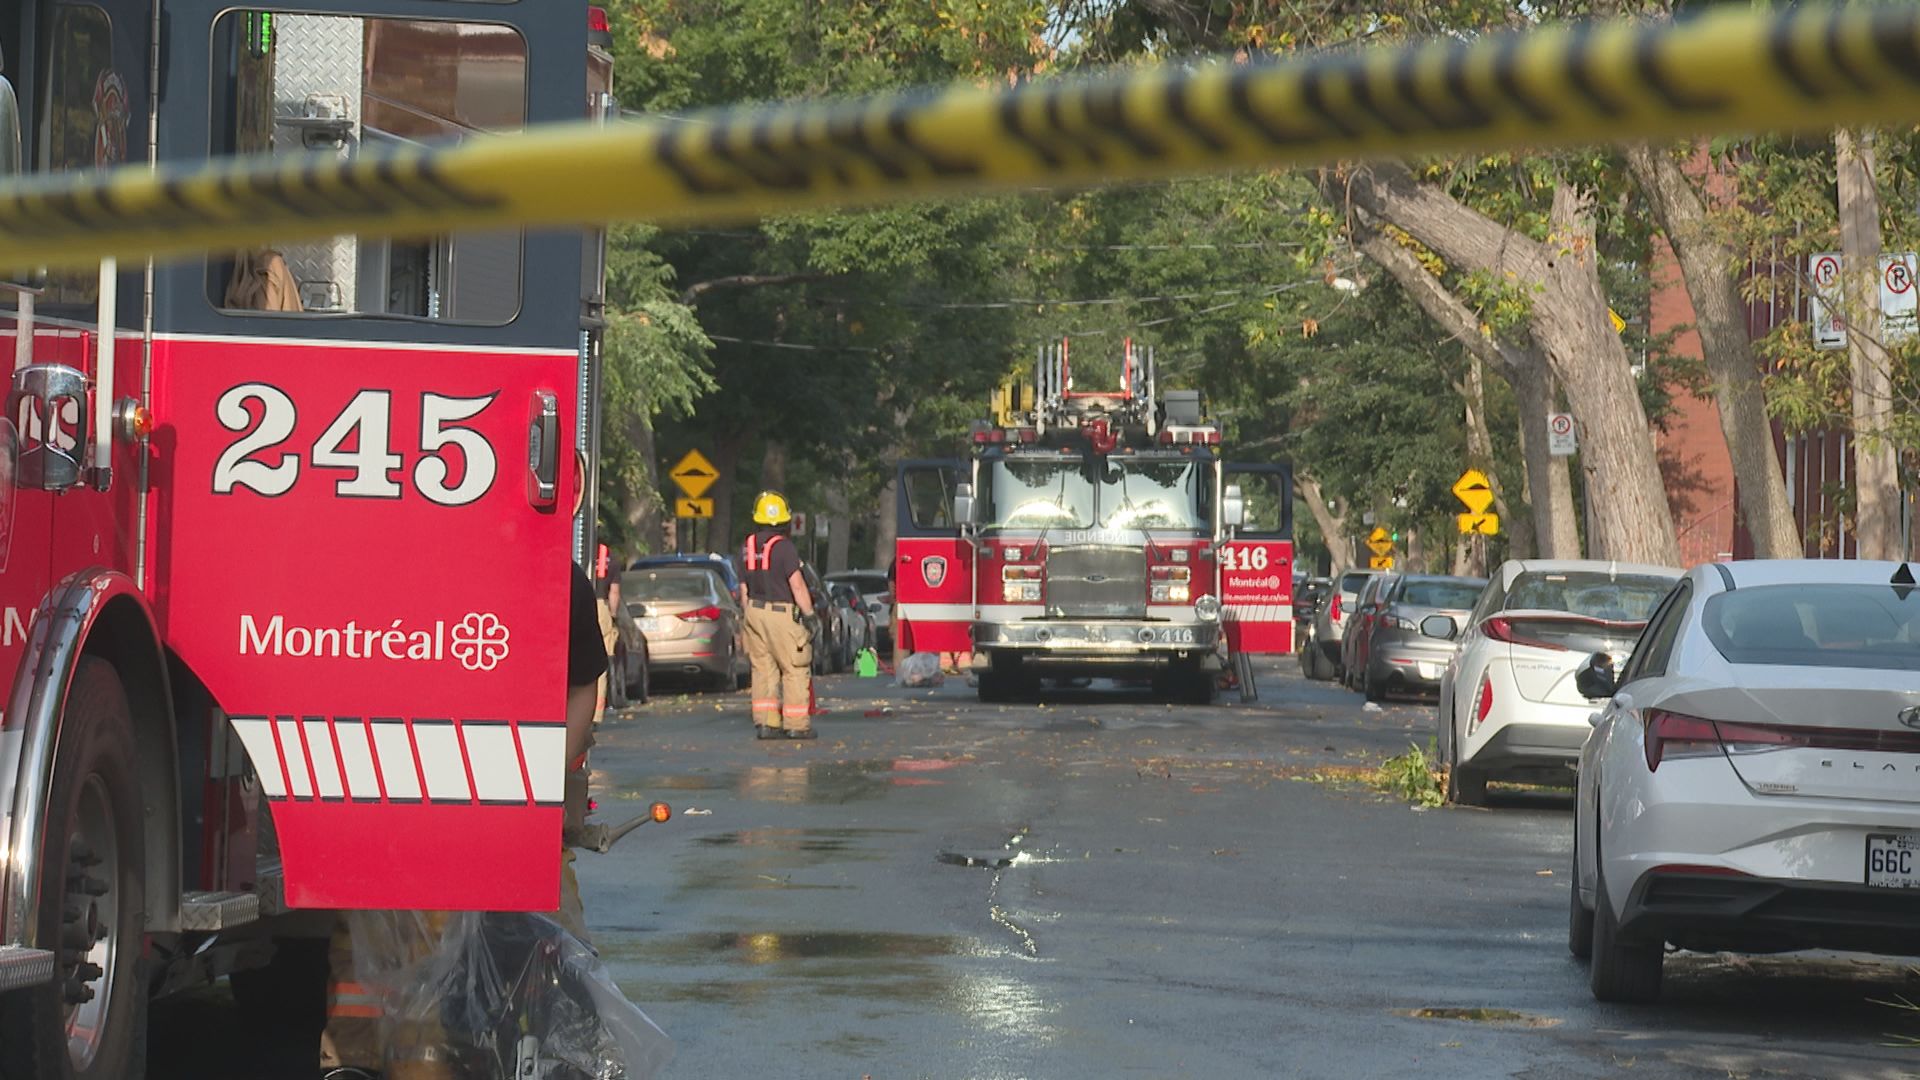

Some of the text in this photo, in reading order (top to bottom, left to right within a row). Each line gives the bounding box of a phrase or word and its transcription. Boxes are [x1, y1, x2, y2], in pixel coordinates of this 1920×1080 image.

[211, 381, 501, 507] 245
[1222, 546, 1268, 570] 416
[1229, 576, 1268, 588] Montréal
[238, 614, 444, 660] Montréal
[1161, 628, 1193, 642] 416
[1871, 848, 1912, 874] 66C
